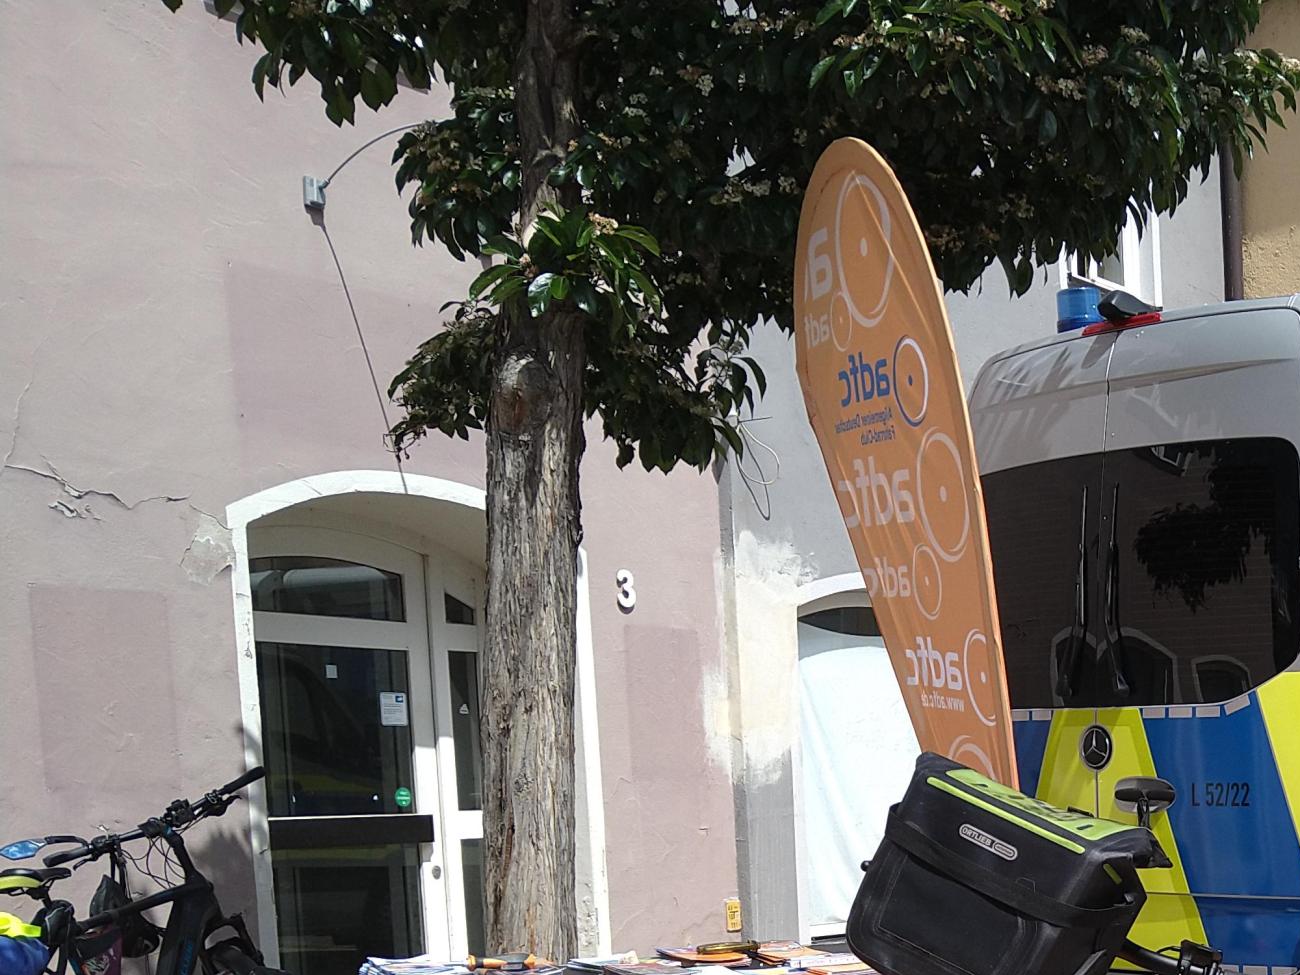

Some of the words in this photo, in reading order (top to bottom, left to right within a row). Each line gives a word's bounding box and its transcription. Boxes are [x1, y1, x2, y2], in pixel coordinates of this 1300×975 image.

[617, 569, 636, 607] 3
[1192, 782, 1201, 806] L
[1205, 782, 1250, 807] 52/22
[962, 827, 992, 846] ORTLIEB
